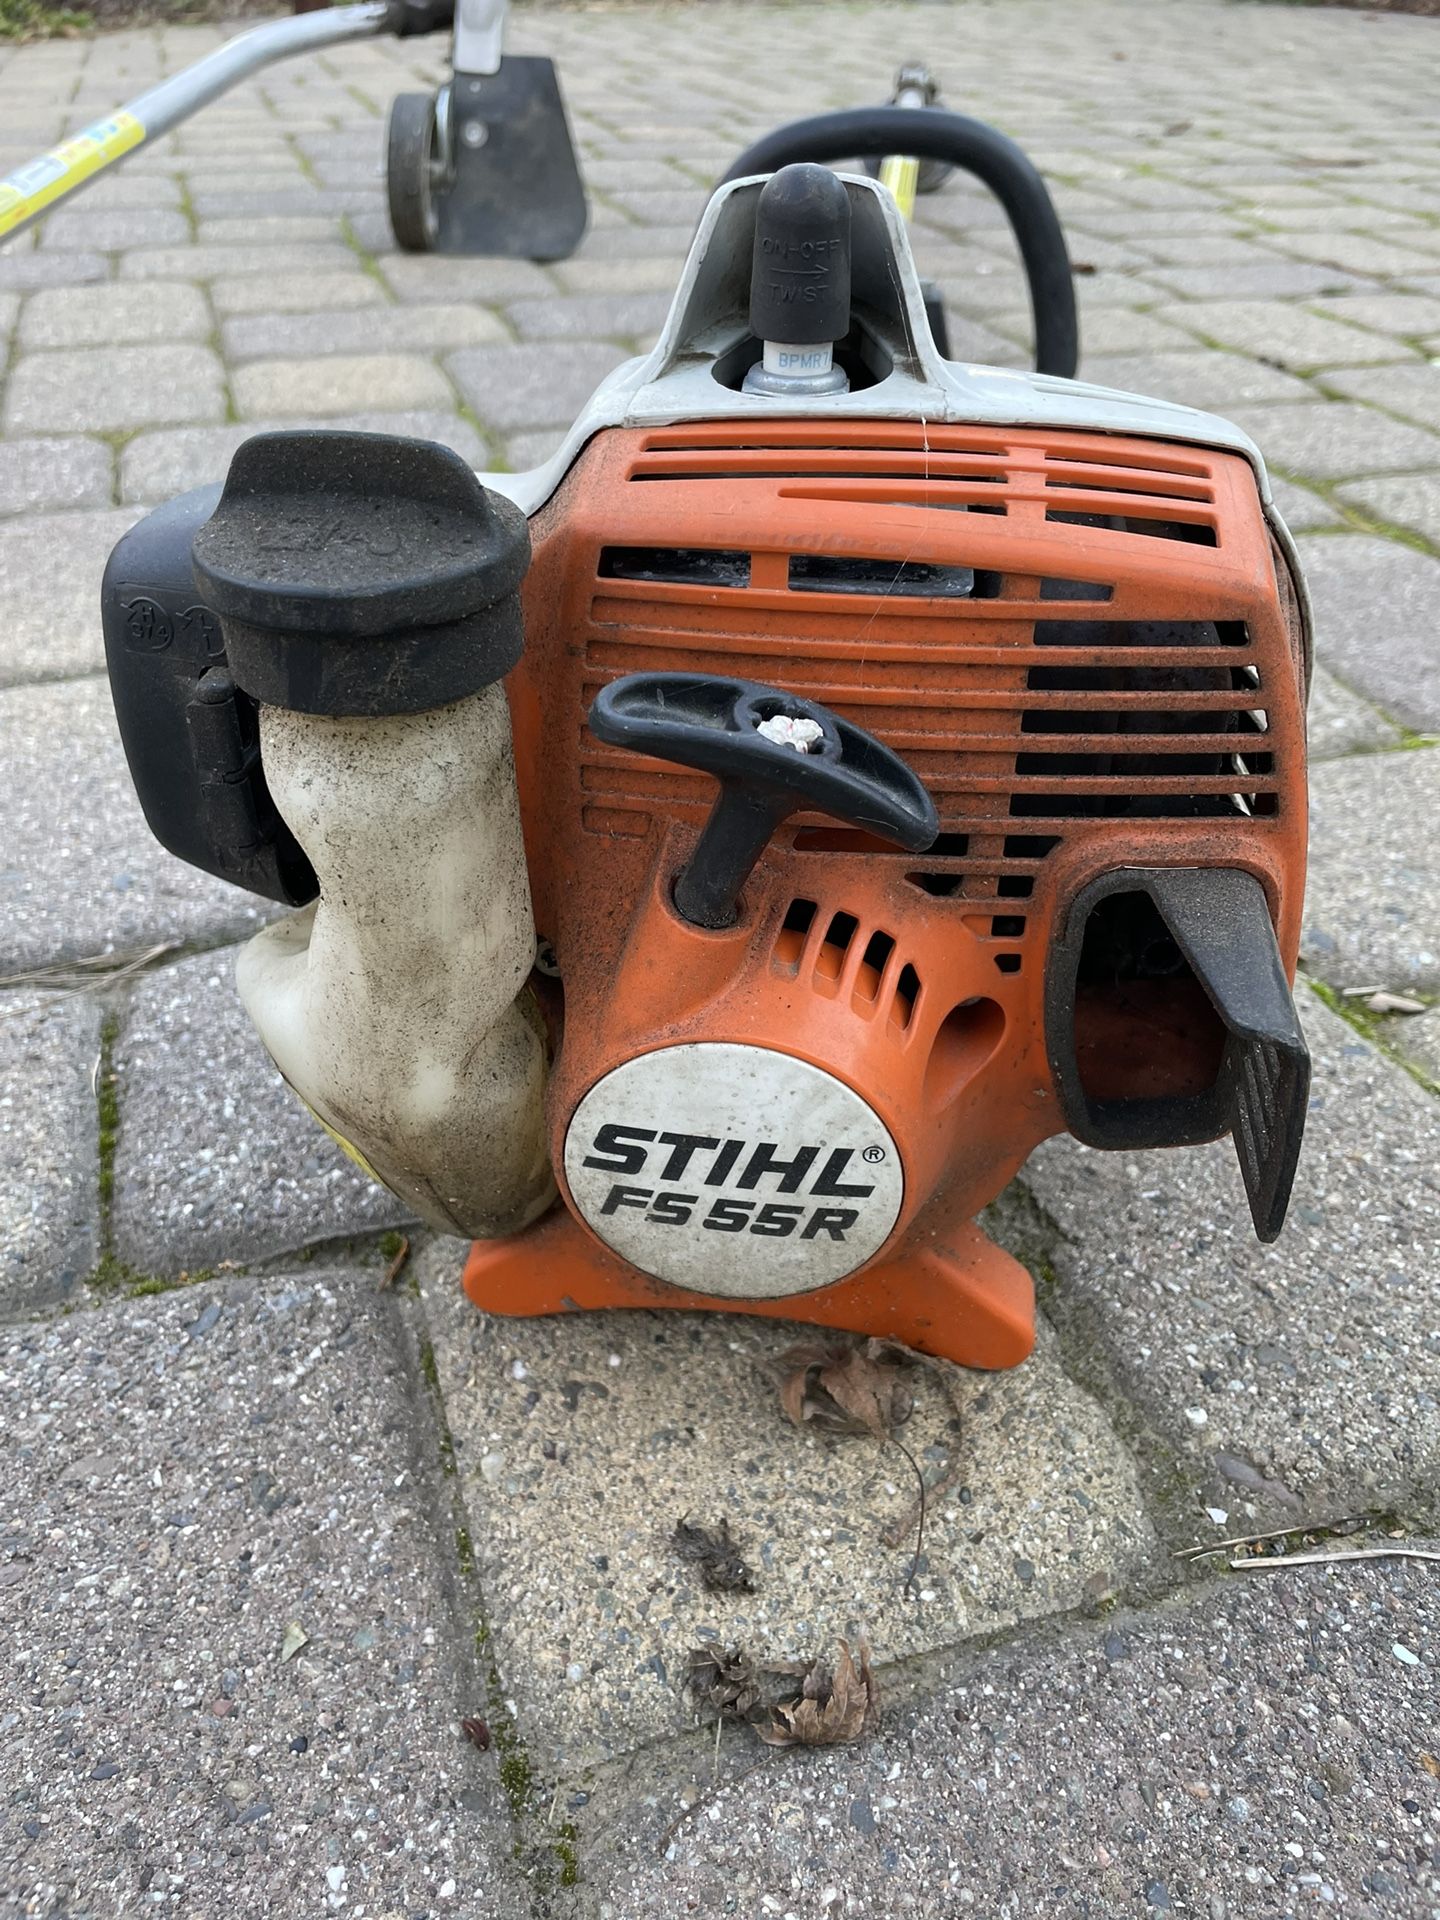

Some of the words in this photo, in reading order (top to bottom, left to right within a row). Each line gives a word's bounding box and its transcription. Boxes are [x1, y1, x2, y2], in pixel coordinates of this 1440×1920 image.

[768, 283, 830, 305] TWIST
[778, 351, 832, 369] BPMR7
[600, 1184, 699, 1227] FS
[702, 1198, 860, 1242] 55R
